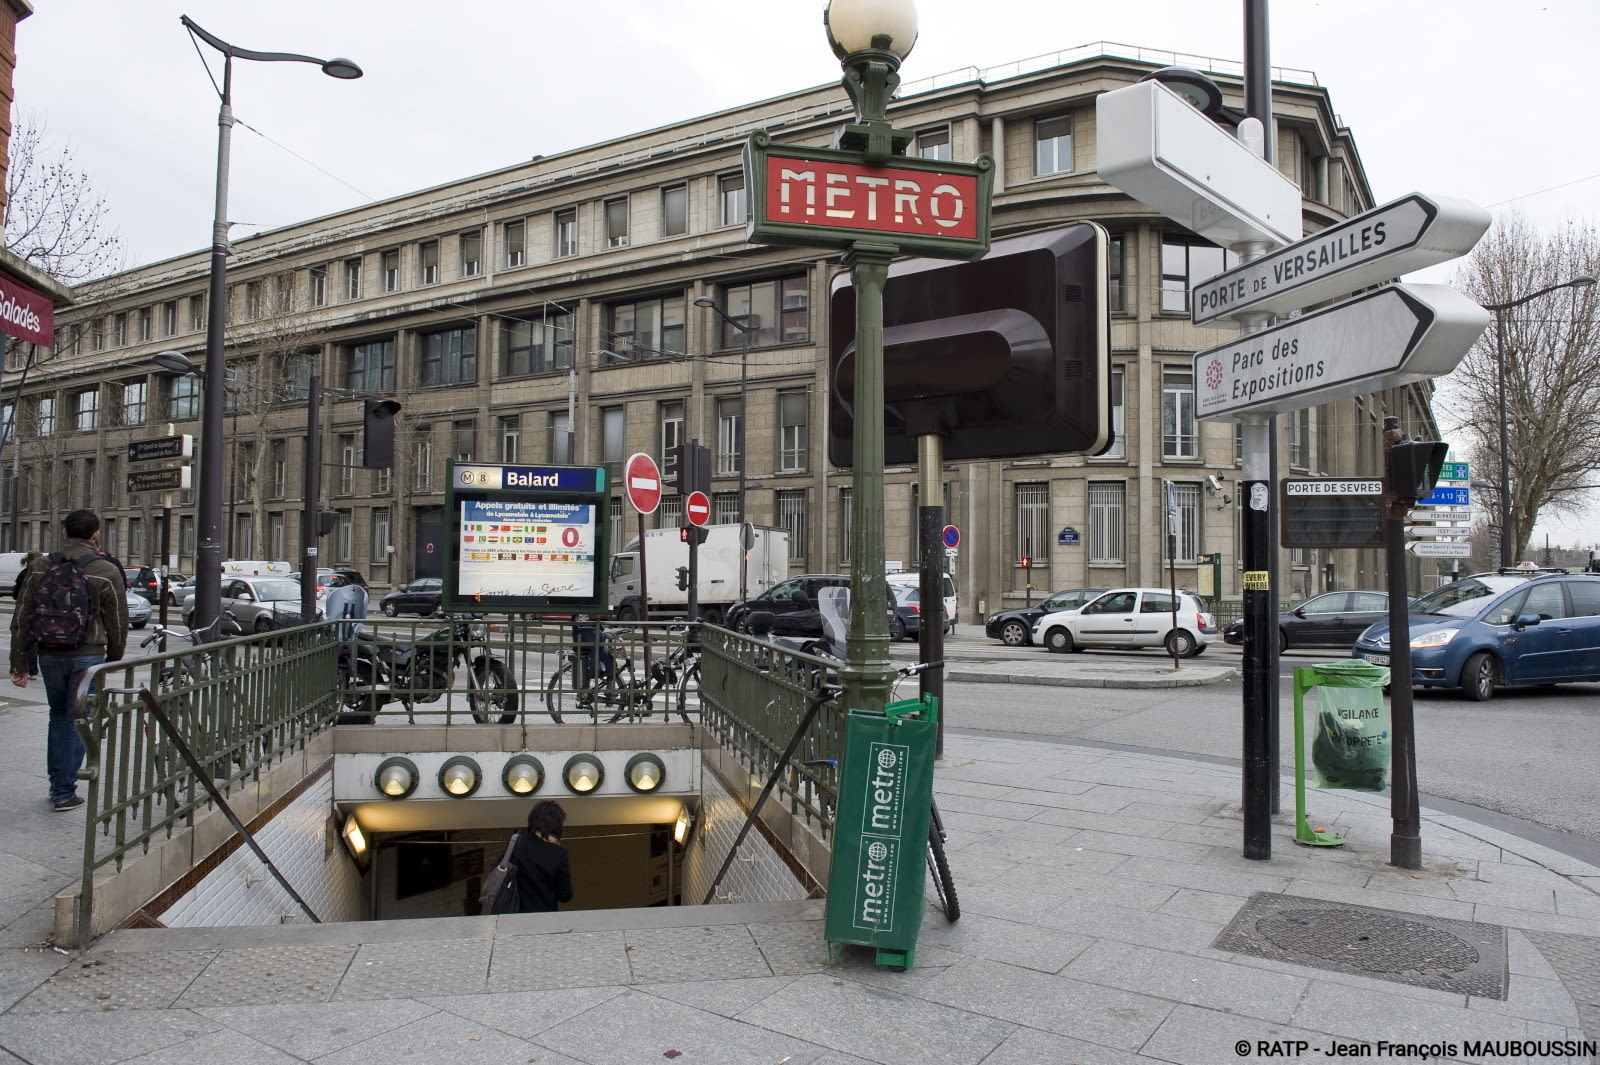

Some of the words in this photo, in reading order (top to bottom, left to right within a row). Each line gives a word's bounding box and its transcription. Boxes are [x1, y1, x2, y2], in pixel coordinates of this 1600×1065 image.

[781, 168, 964, 227] METRO
[1200, 278, 1245, 312] PORTE
[1253, 276, 1267, 293] DE
[1274, 221, 1386, 284] VERSAILLES
[1232, 349, 1264, 373] Parc
[1272, 338, 1298, 361] des
[1232, 360, 1324, 400] Expositions
[479, 474, 486, 482] 8
[507, 472, 559, 487] Balard
[1288, 483, 1321, 493] PORTE
[1324, 483, 1338, 493] DE
[1340, 483, 1381, 492] SEVRES
[475, 501, 503, 510] Appels
[504, 502, 536, 511] gratuits
[1244, 581, 1268, 590] WHERE
[1245, 573, 1266, 582] EVERY
[871, 749, 897, 829] metro
[892, 751, 904, 830] www.metrofrance.com
[862, 841, 888, 924] metro
[883, 843, 895, 924] www.metrofrance.com
